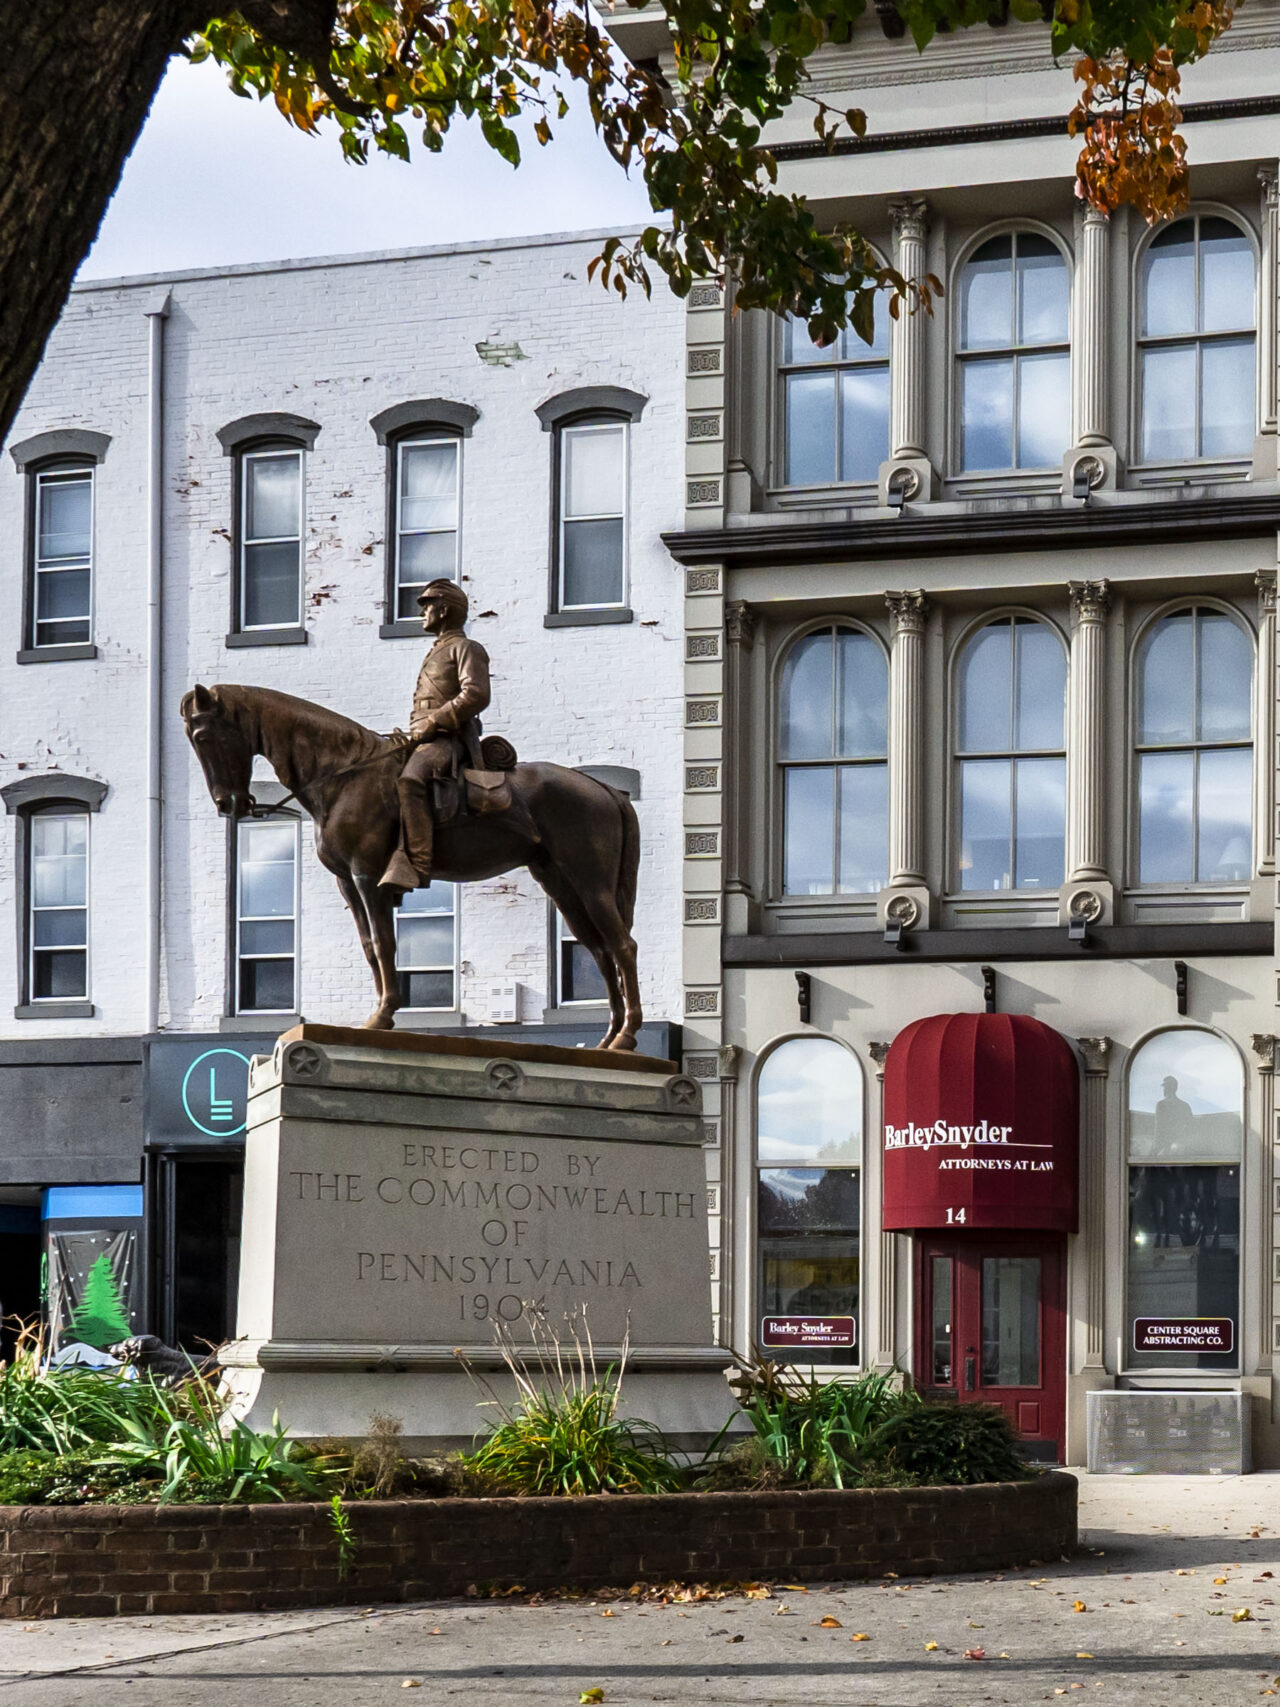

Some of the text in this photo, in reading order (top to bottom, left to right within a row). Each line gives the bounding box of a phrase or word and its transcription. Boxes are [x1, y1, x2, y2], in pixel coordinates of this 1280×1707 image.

[402, 1143, 601, 1177] ERECTED BY
[938, 1159, 1054, 1172] ATTORNEYS AT LAW
[290, 1171, 697, 1219] THE COMMONWEALTH
[945, 1207, 966, 1225] 14
[481, 1219, 529, 1247] OF
[356, 1252, 643, 1288] PENNSYLVANIA
[769, 1322, 833, 1335] Barley Snyder
[1147, 1326, 1220, 1336] CENTER SQUARE
[1143, 1336, 1224, 1345] ABSTRACTING CO.
